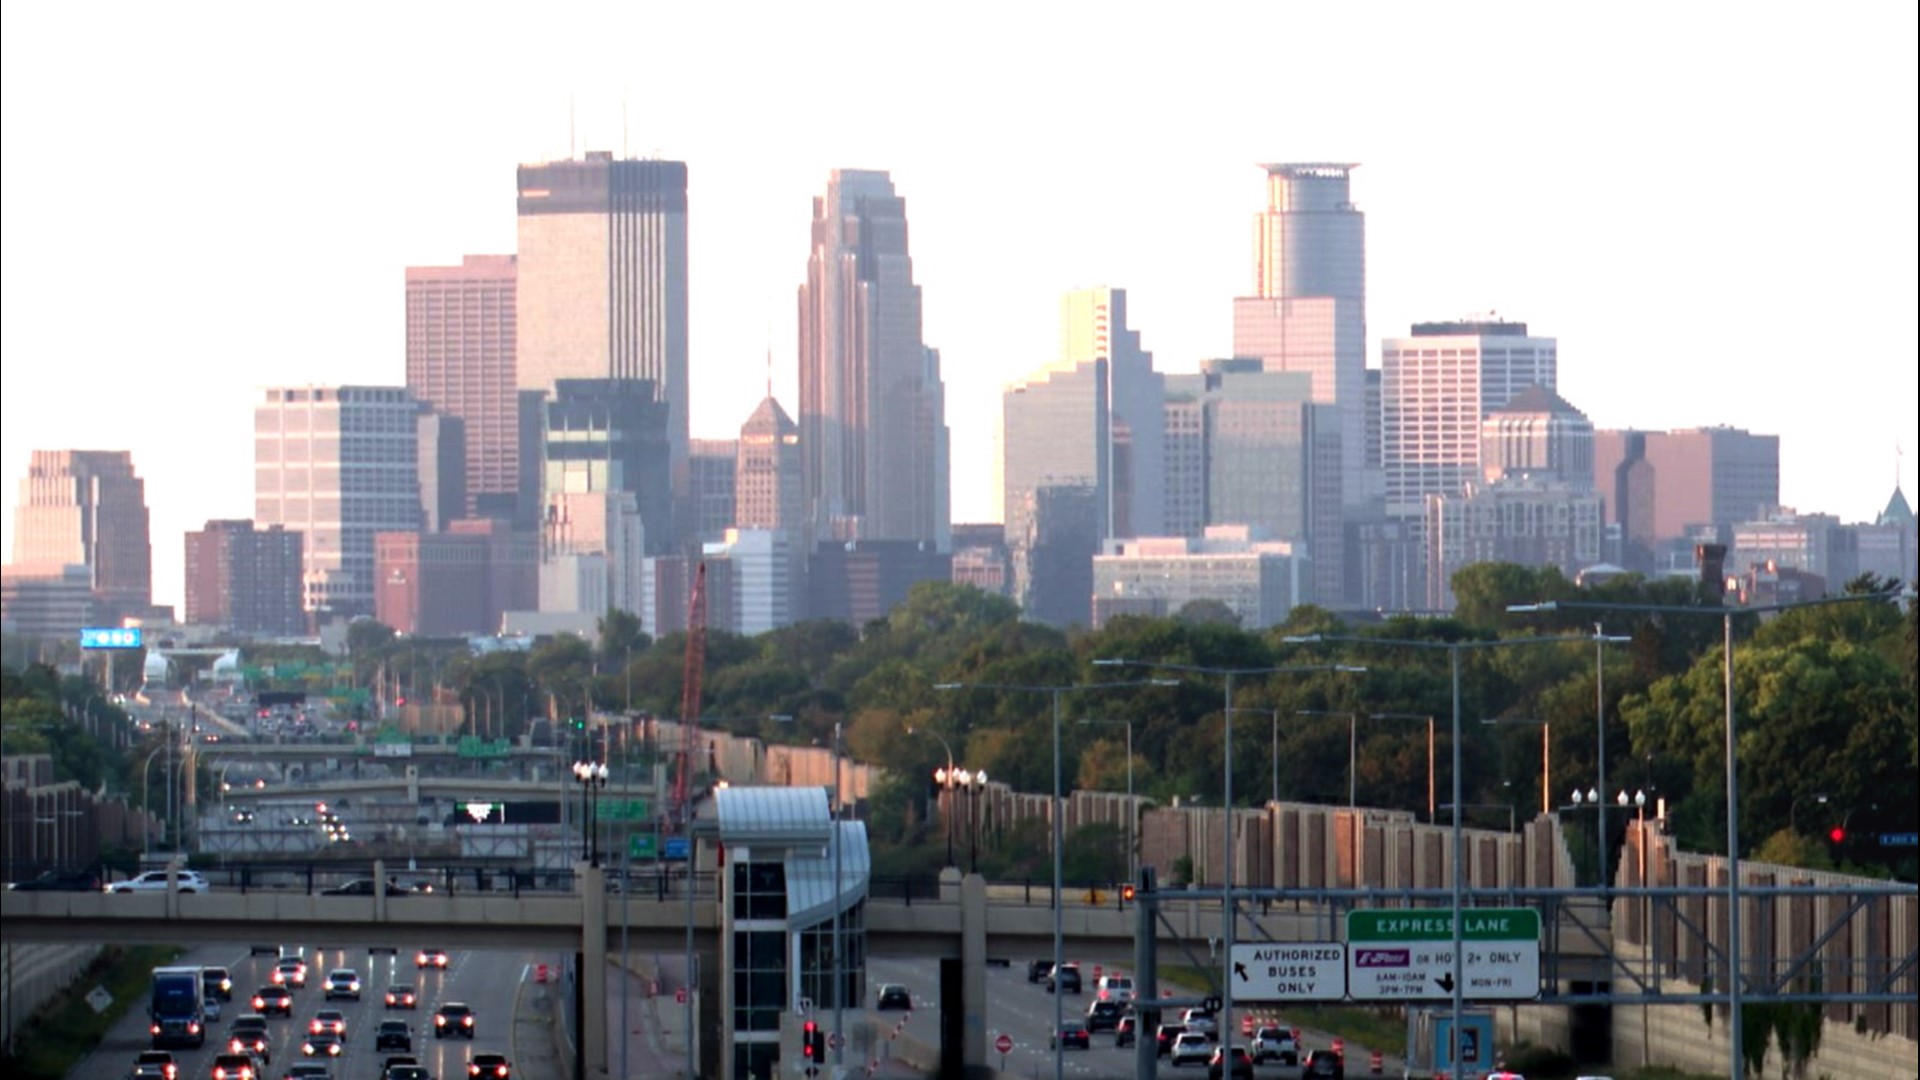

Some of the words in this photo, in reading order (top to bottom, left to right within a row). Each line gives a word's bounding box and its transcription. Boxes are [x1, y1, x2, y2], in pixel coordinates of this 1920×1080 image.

[1377, 919, 1455, 932] EXPRESS
[1465, 918, 1509, 932] LANE
[1254, 949, 1340, 960] AUTHORIZED
[1416, 955, 1430, 964] OR
[1435, 952, 1459, 964] HO
[1489, 952, 1520, 963] ONLY
[1268, 966, 1316, 977] BUSES
[1277, 982, 1315, 994] ONLY
[1471, 979, 1511, 987] MON-FRI
